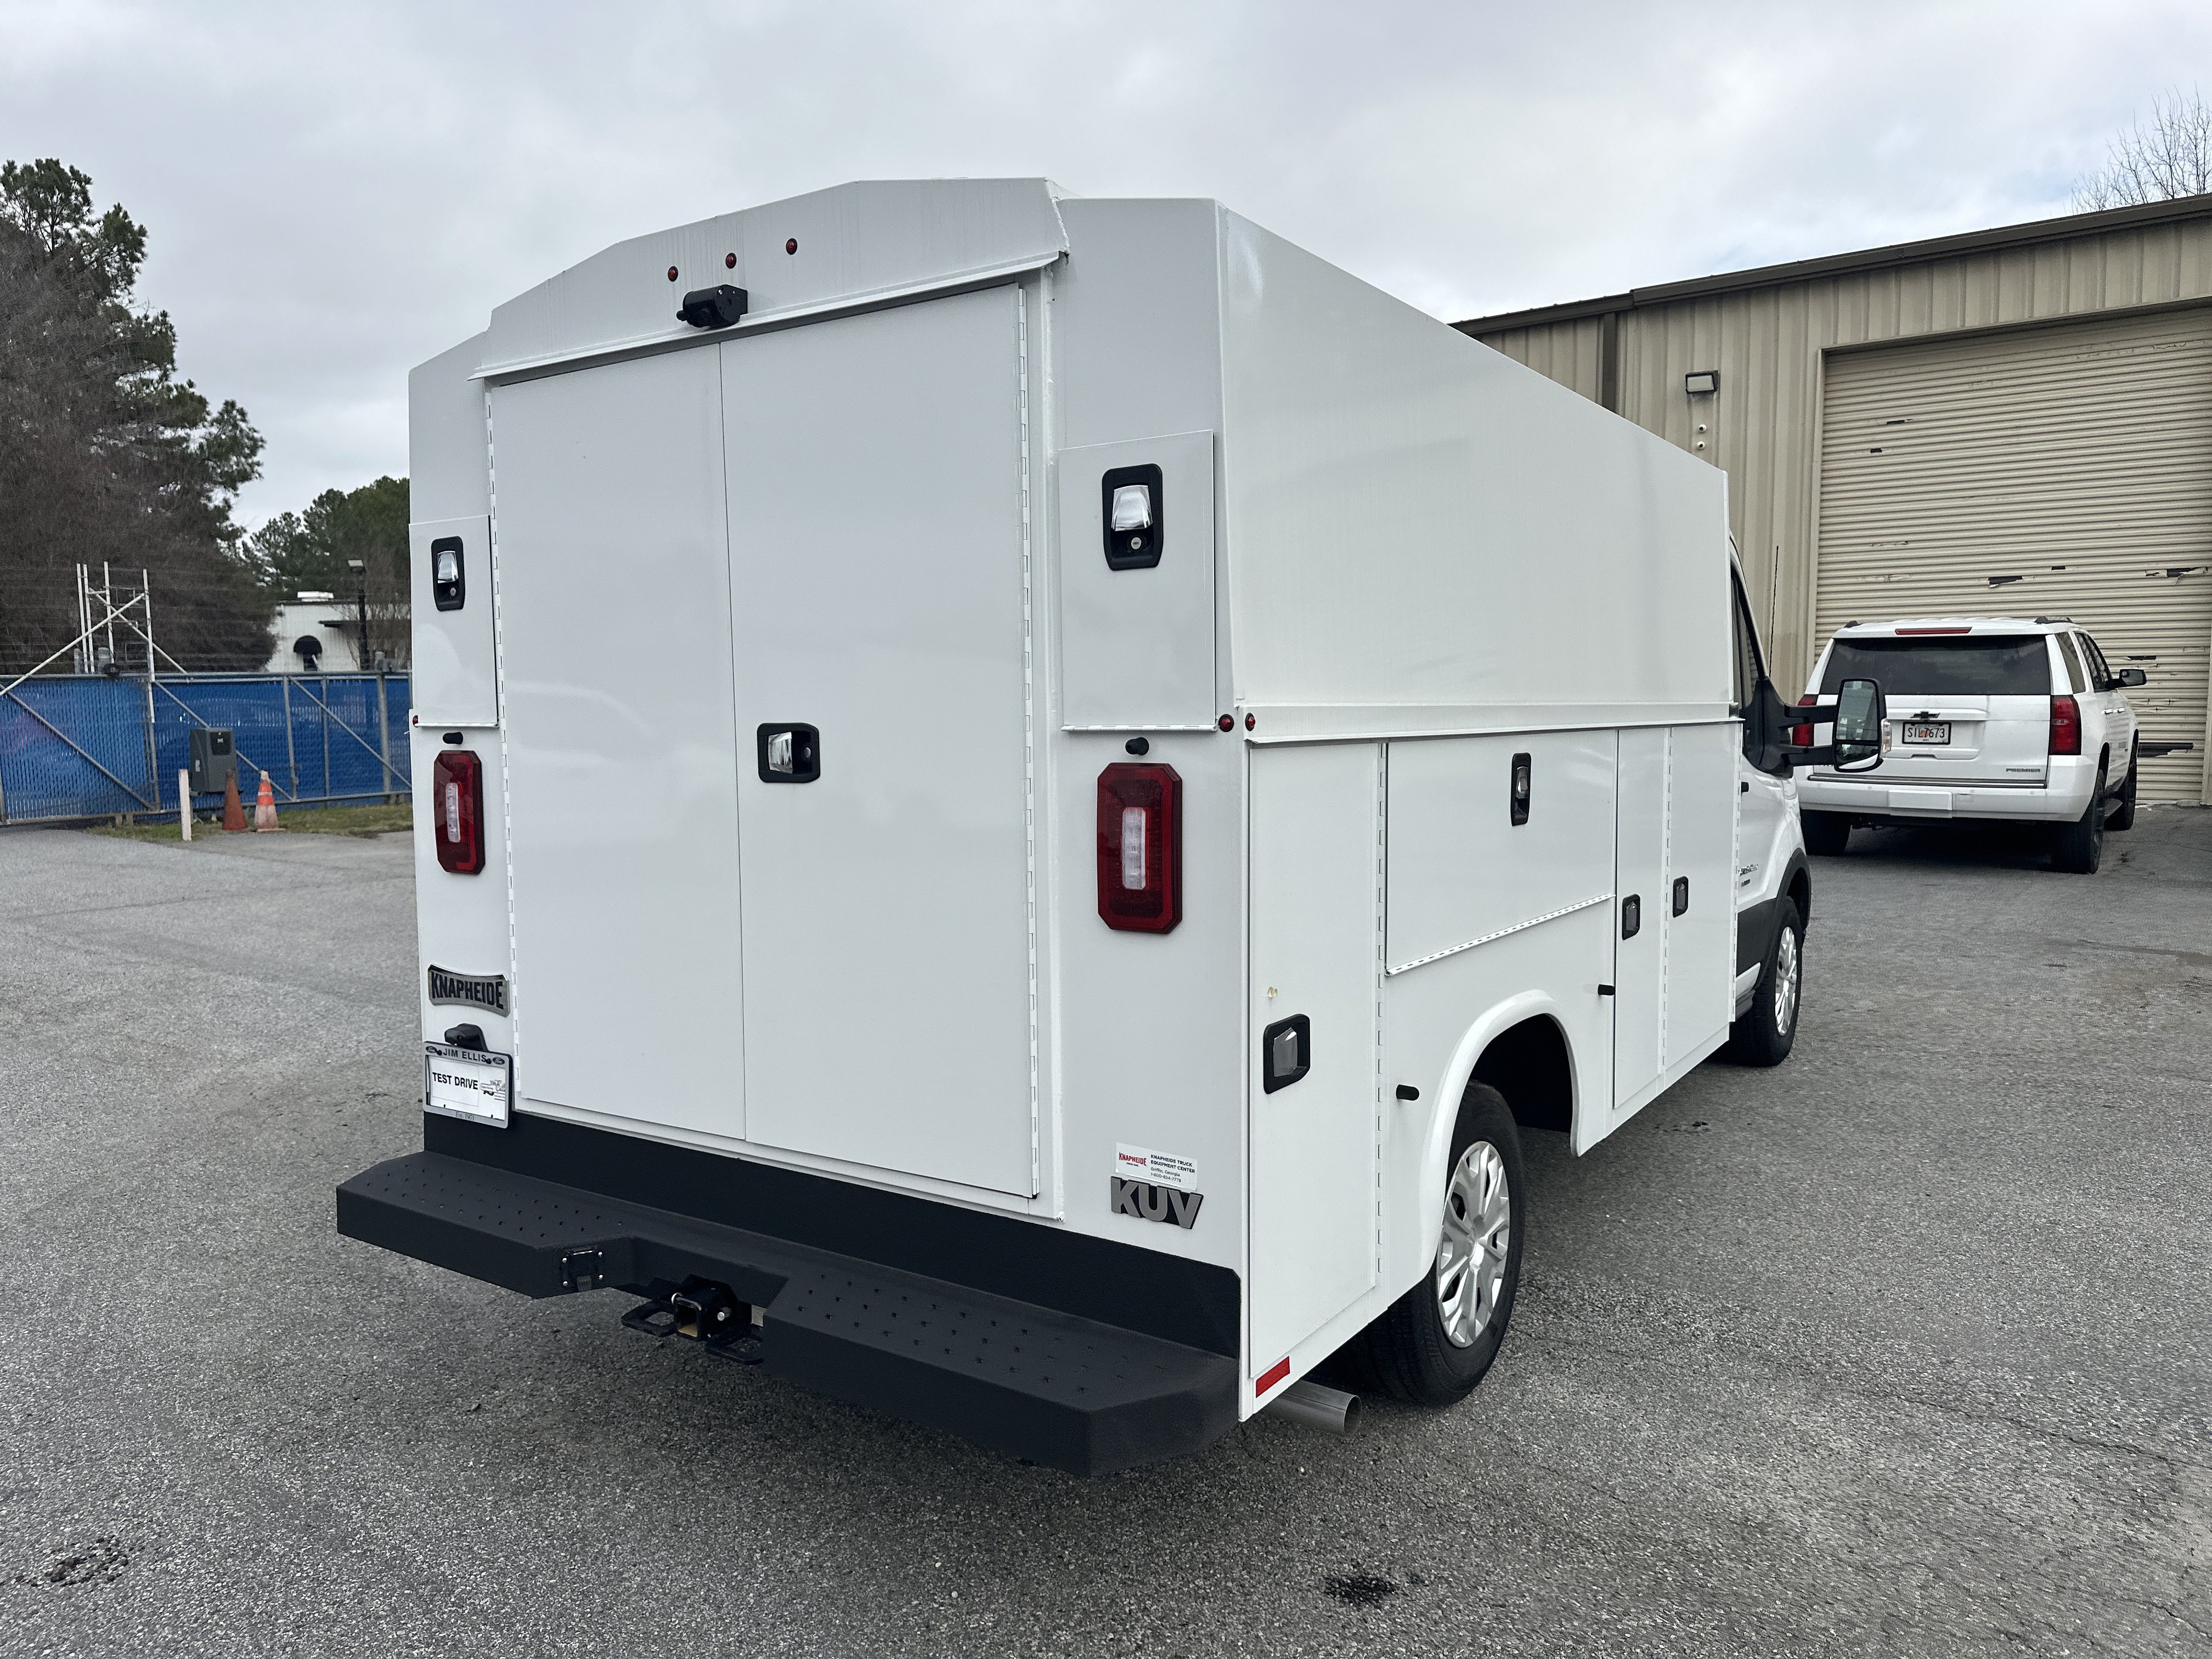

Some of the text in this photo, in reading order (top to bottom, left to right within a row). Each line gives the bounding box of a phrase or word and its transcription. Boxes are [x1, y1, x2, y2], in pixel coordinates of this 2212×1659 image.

[431, 971, 504, 1010] KNAPHEIDE
[443, 1048, 458, 1058] JIM
[462, 1051, 487, 1063] ELLIS
[432, 1071, 478, 1090] TEST DRIVE
[1119, 1152, 1147, 1166] KNAPHEIDE
[1150, 1154, 1176, 1164] KNAPHEIDE
[1150, 1160, 1176, 1170] EQUIPMENT
[1111, 1176, 1204, 1229] KUV
